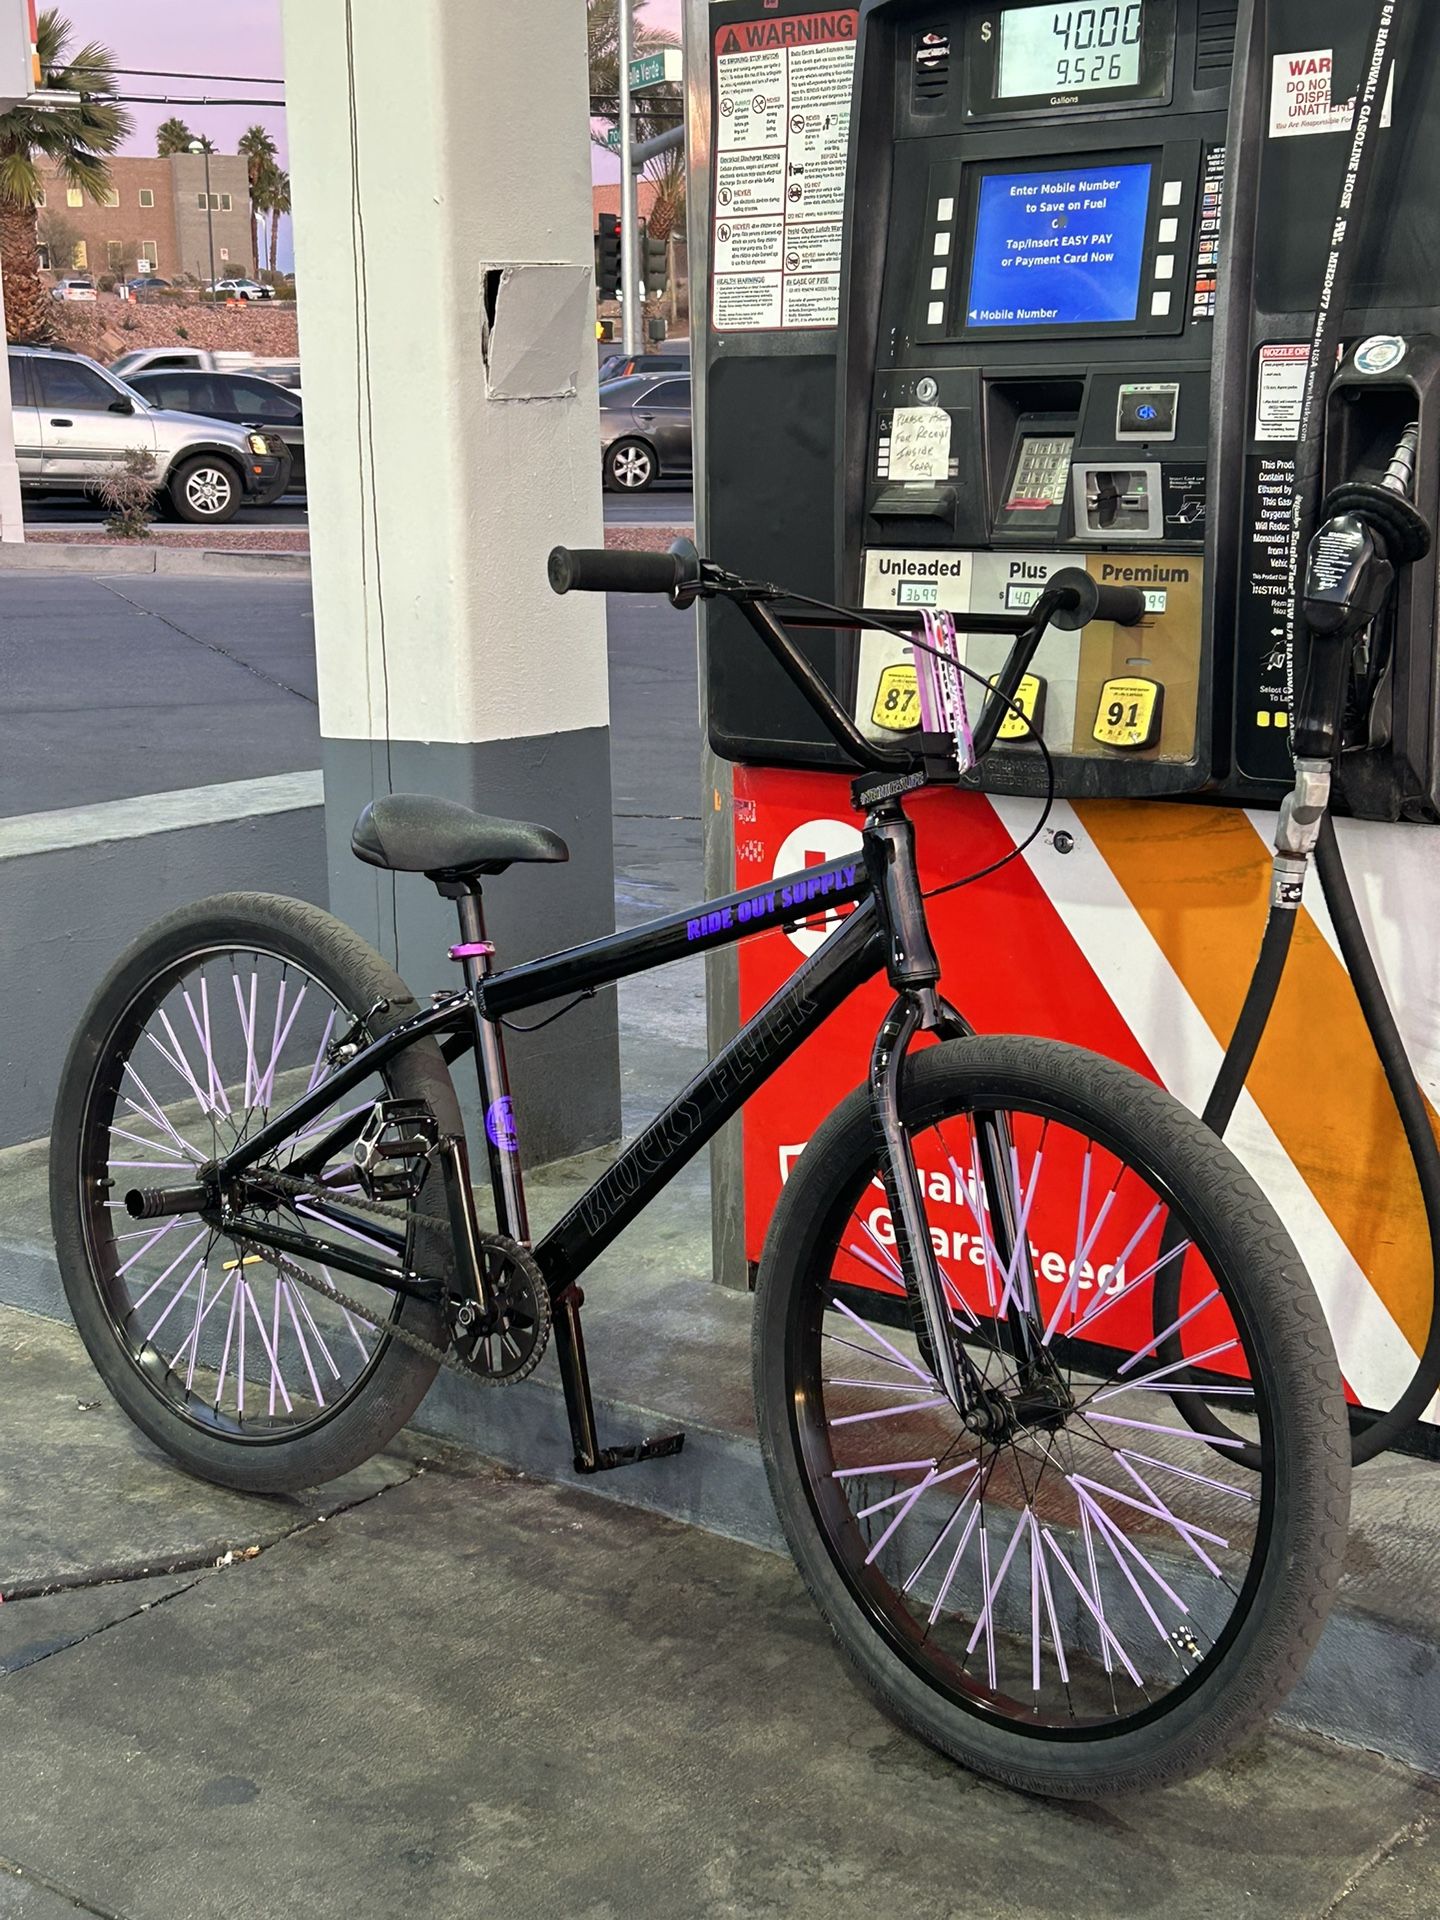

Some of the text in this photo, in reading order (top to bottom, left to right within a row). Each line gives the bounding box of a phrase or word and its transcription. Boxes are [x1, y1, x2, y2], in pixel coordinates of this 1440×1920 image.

[1381, 5, 1394, 25] 5/8
[745, 14, 853, 48] WARNING
[981, 4, 1141, 50] $ 40.00
[1057, 54, 1121, 85] 9.526
[1289, 58, 1331, 76] WAR
[1363, 28, 1389, 102] HARDWALL
[1287, 81, 1305, 93] DO
[1050, 95, 1078, 105] Gallons
[1296, 90, 1331, 104] DISPE
[1348, 105, 1371, 171] GASOLINE
[1010, 180, 1121, 196] Enter Mobile Number
[1340, 173, 1356, 209] HOSE
[1026, 198, 1107, 213] to Save on Fuel
[1006, 233, 1113, 251] Tap/Insert EASY PAY
[1001, 251, 1115, 268] or Payment Card Now
[1320, 252, 1339, 309] MH20477
[980, 308, 1058, 320] Mobile Number
[1263, 347, 1294, 357] NOZZLE
[1310, 348, 1320, 368] USA
[1261, 460, 1275, 469] This
[1258, 472, 1284, 481] Contain
[1258, 485, 1292, 495] Ethanol by
[1262, 497, 1276, 506] This
[1255, 521, 1268, 530] Will
[879, 559, 961, 577] Unleaded
[1009, 561, 1047, 579] Plus
[1102, 563, 1189, 583] Premium
[1252, 585, 1287, 595] INSTRU
[1149, 594, 1164, 608] 99
[1260, 685, 1281, 694] Select
[885, 689, 916, 712] 87
[1009, 697, 1024, 720] 9
[1107, 702, 1138, 727] 91
[686, 906, 734, 941] RIDE
[738, 891, 776, 923] OUT
[781, 864, 857, 909] SUPPLY
